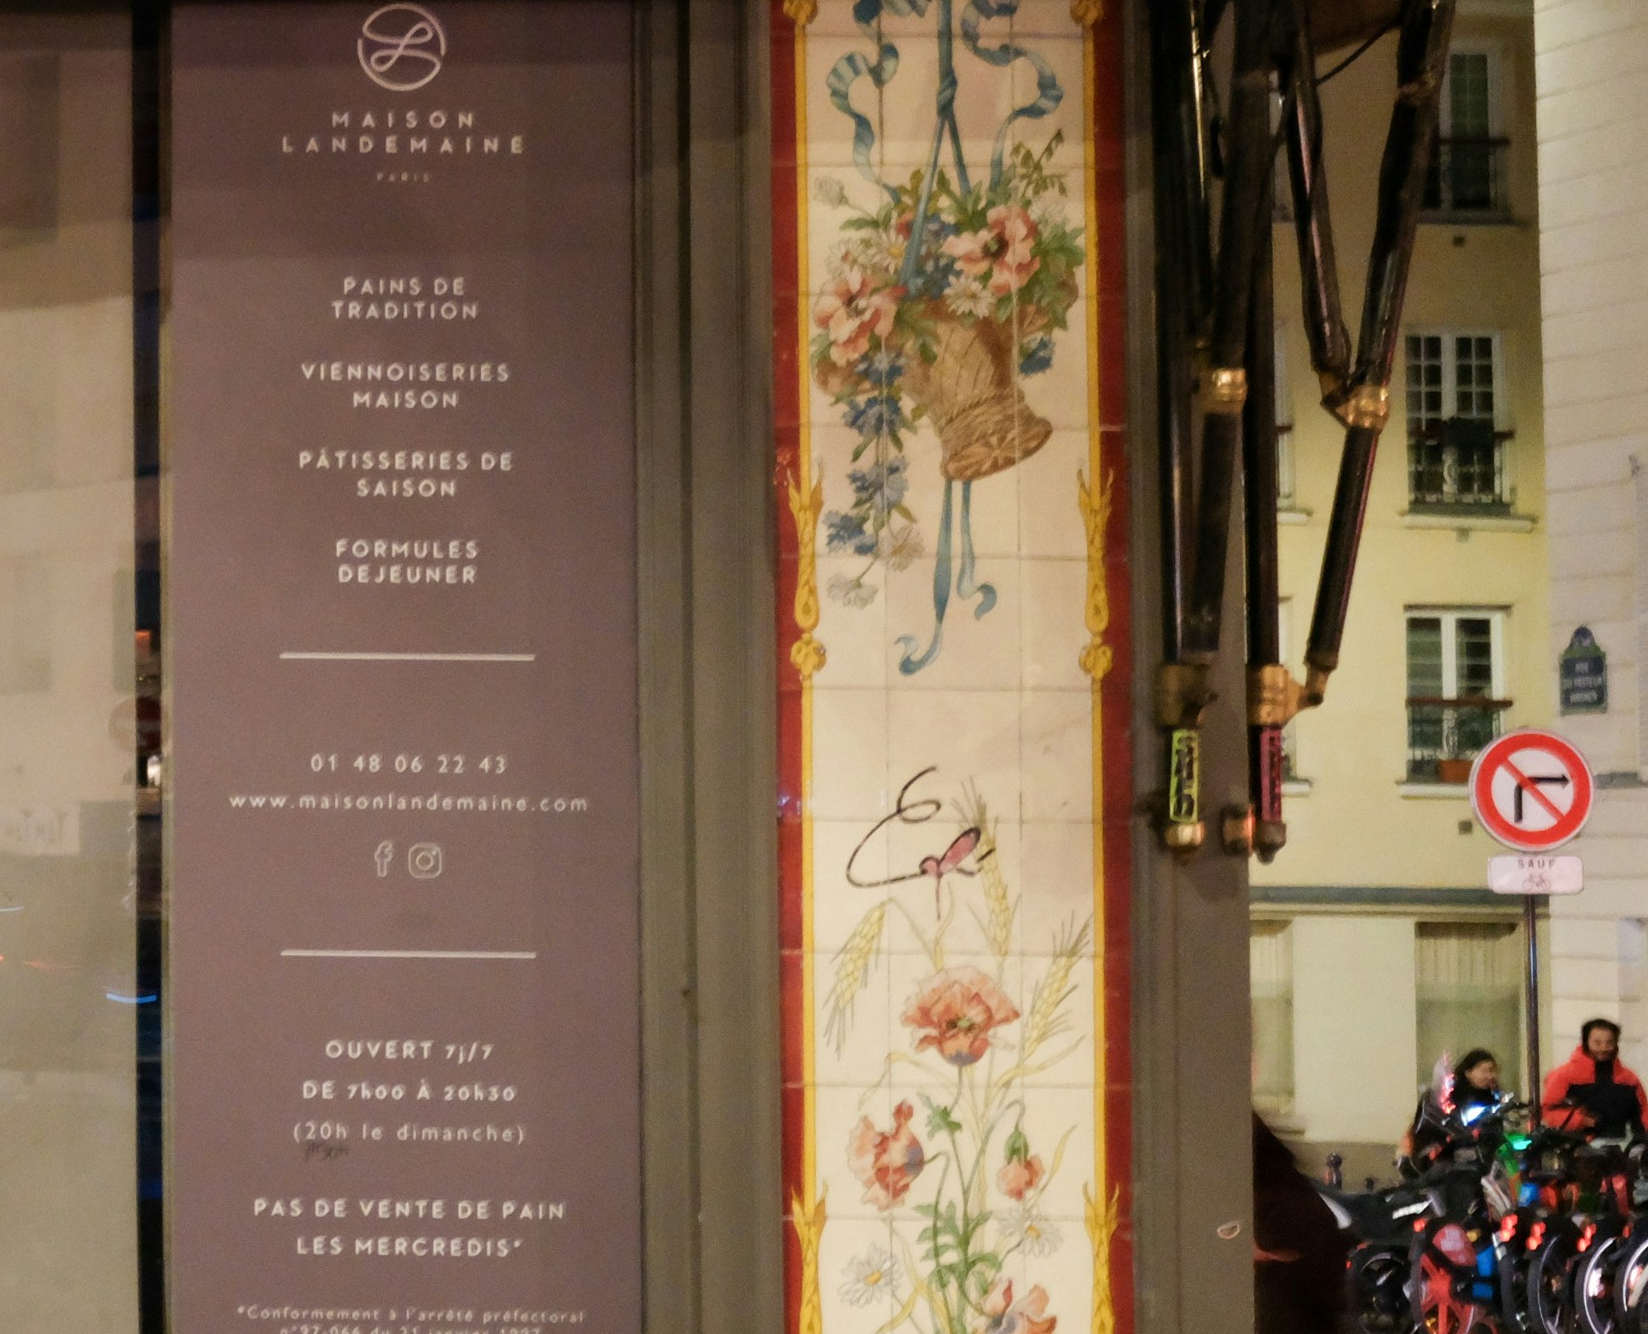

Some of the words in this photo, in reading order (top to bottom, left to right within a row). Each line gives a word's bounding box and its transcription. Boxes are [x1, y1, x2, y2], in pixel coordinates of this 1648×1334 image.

[331, 109, 474, 130] MAISON
[281, 134, 524, 155] LANDEMAINE
[342, 276, 422, 296] PAINS
[433, 276, 465, 297] DE
[331, 299, 478, 320] TRADITION
[300, 361, 511, 382] VIENNOISERIES
[352, 389, 458, 410] MAISON
[480, 450, 513, 472] DE
[356, 477, 457, 498] SAISON
[334, 537, 480, 560] FORMULES
[309, 752, 337, 773] 01
[352, 753, 382, 773] 48
[393, 753, 424, 774] 06
[436, 753, 465, 775] 22
[478, 755, 507, 775] 43
[228, 792, 587, 813] www.maisonlandemaine.com
[1516, 858, 1556, 869] SAUF
[324, 1038, 434, 1060] OUVERT
[301, 1079, 335, 1101] DE
[347, 1078, 406, 1101] 7h00
[415, 1077, 432, 1101] À
[443, 1082, 518, 1103] 20h30
[292, 1120, 348, 1143] (20h
[361, 1122, 383, 1142] le
[395, 1122, 525, 1145] dimanche)
[252, 1197, 304, 1218] PAS
[313, 1197, 346, 1219] DE
[358, 1198, 446, 1220] VENTE
[456, 1199, 489, 1221] DE
[501, 1199, 566, 1220] PAIN
[295, 1235, 344, 1257] LES
